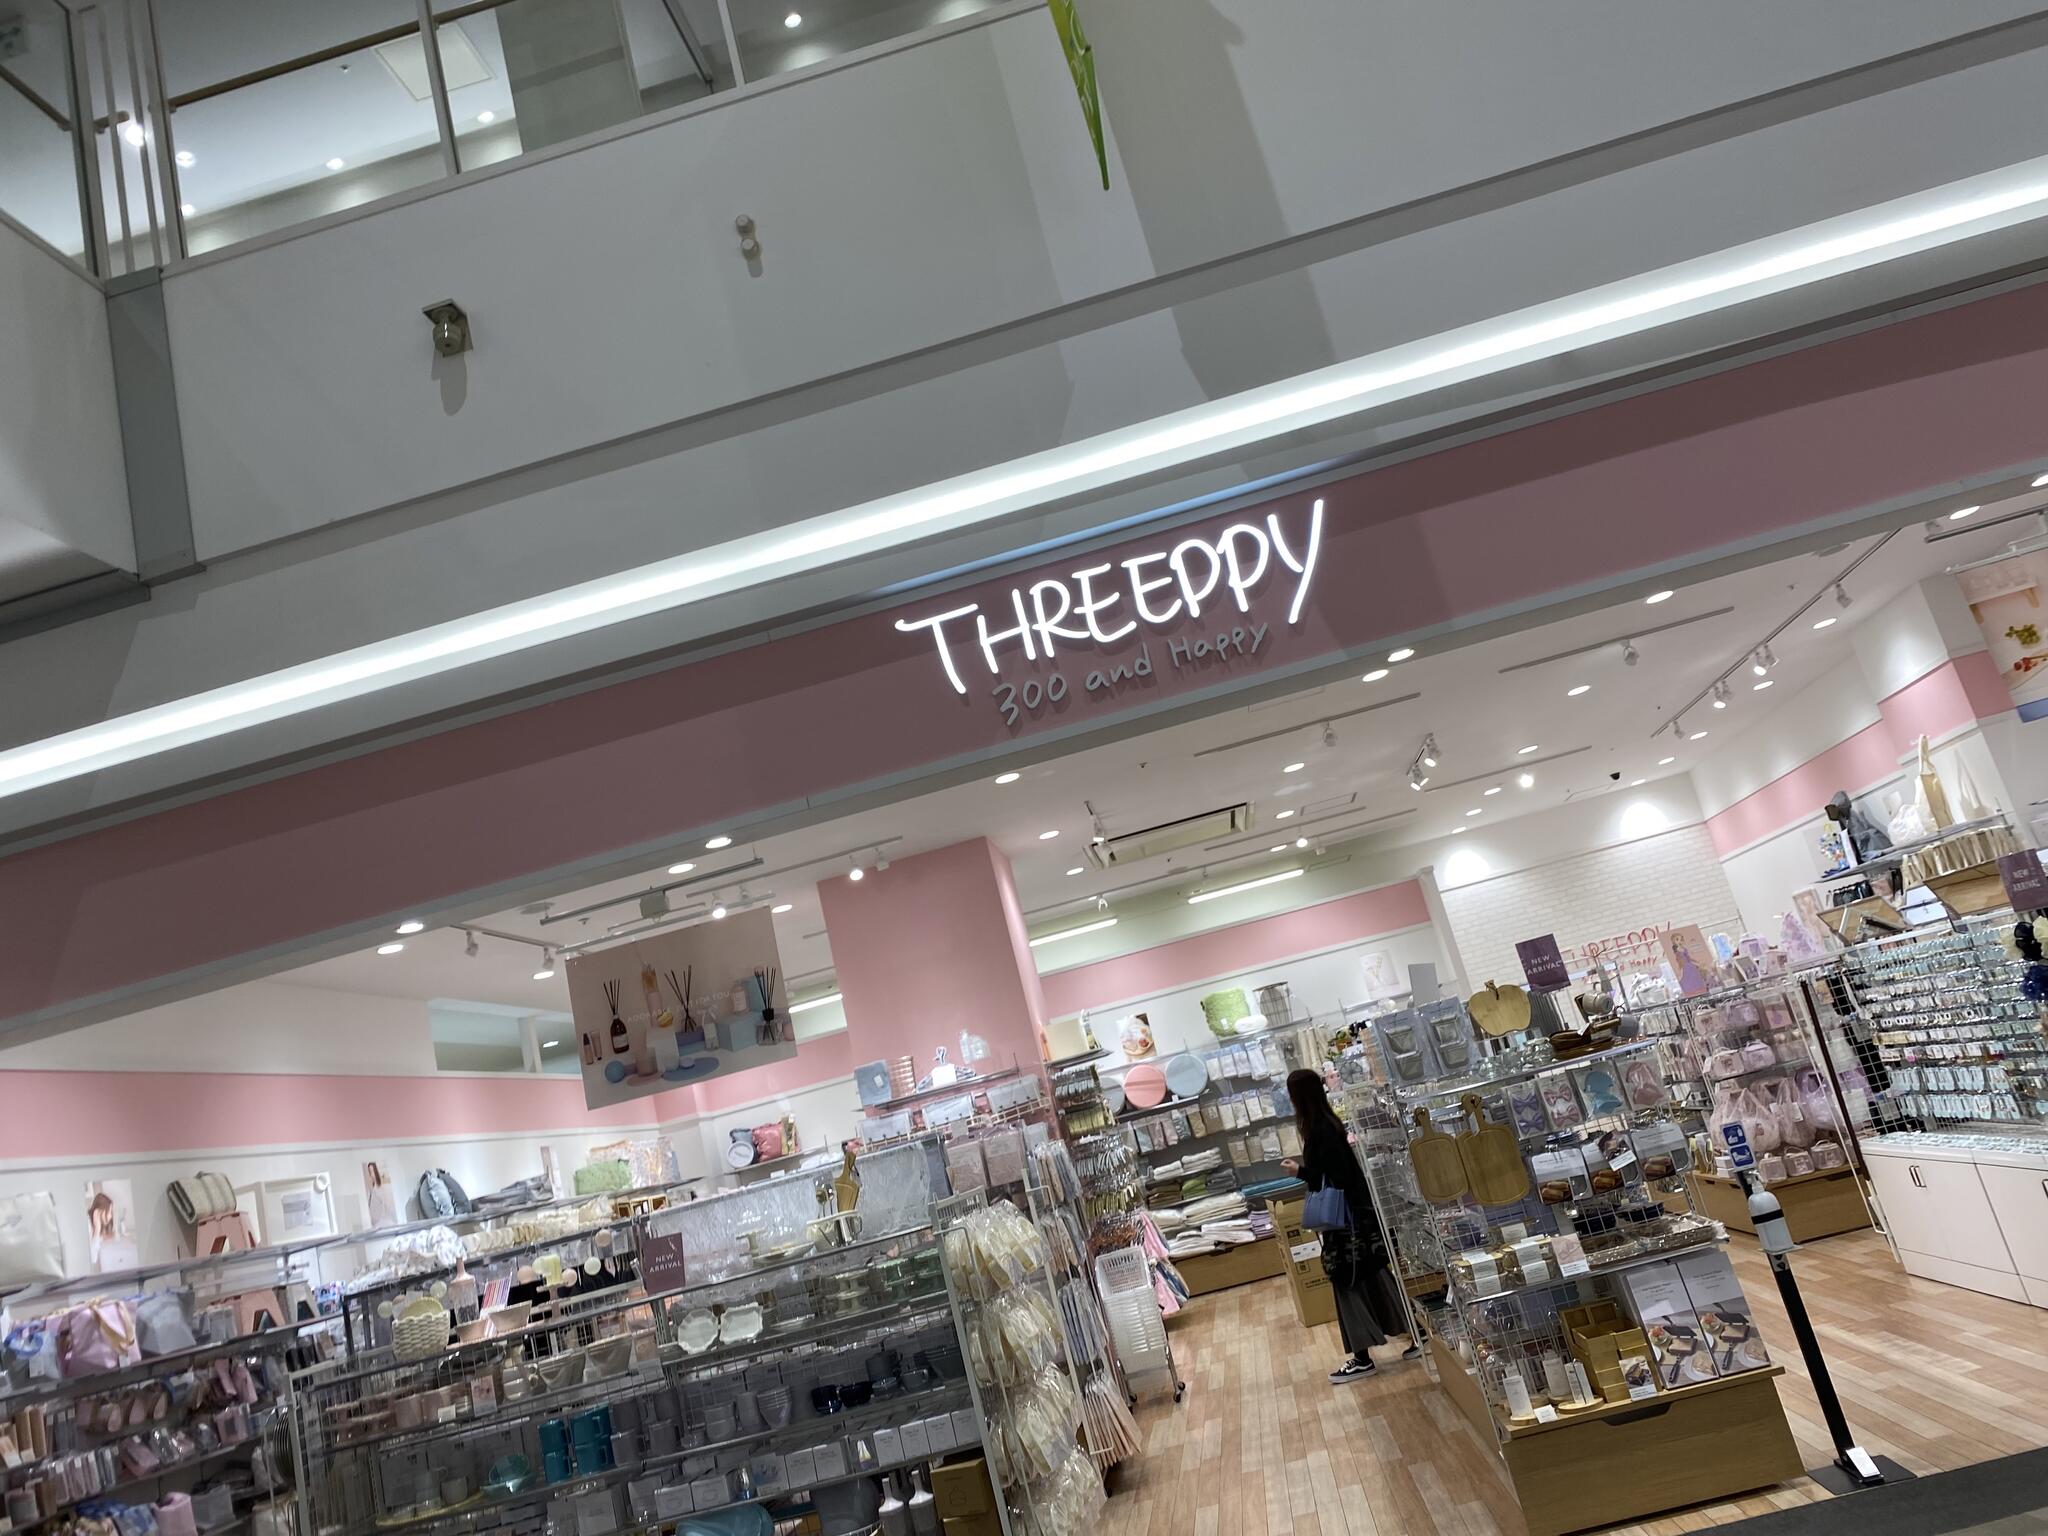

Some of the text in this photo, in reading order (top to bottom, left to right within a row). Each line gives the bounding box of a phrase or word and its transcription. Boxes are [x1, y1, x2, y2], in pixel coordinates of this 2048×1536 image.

[895, 499, 1325, 695] THREEPPY
[992, 622, 1268, 726] 300 and Happy
[1560, 921, 1670, 969] HREEPP
[1531, 954, 1551, 965] NEW
[1527, 960, 1563, 976] ARRIVAL
[655, 1253, 674, 1263] NEW
[649, 1260, 682, 1273] ARRIVAL
